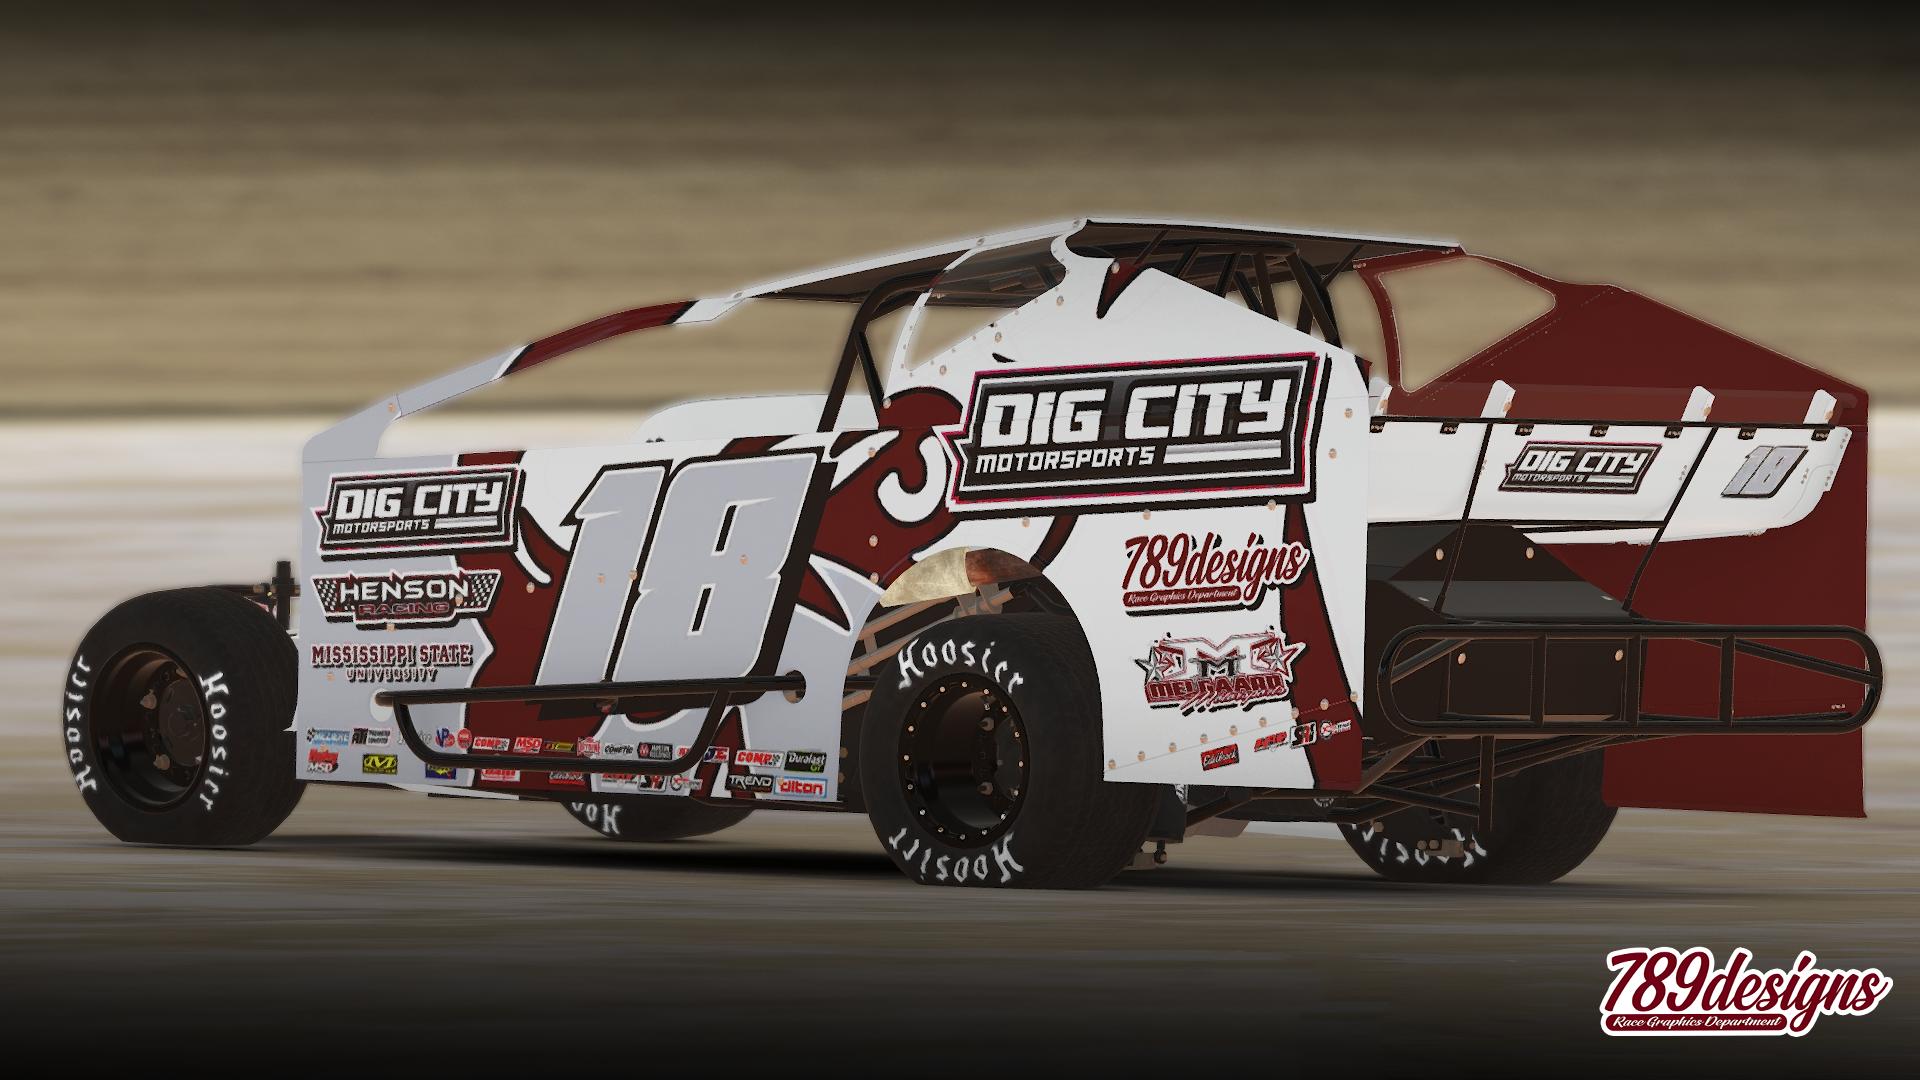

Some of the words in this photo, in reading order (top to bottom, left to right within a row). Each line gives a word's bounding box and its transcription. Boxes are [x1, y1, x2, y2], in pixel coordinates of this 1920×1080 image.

[980, 389, 1107, 448] DIG
[1124, 378, 1294, 439] CITY
[975, 446, 1157, 474] MOTORSPORTS
[1517, 450, 1576, 473] DIG
[1575, 451, 1648, 474] CITY
[1720, 446, 1808, 498] 18
[1512, 473, 1585, 483] MOTORSPORTS
[335, 486, 404, 521] DIG
[412, 481, 504, 517] CITY
[332, 518, 431, 535] MOTORSPORTS
[534, 452, 820, 687] 18
[1121, 531, 1309, 602] 789designs
[339, 578, 469, 603] HENSON
[358, 602, 450, 615] RACING
[311, 644, 415, 665] MISSISSIPPI
[418, 643, 474, 664] STATE
[897, 638, 1024, 694] Hoosier
[346, 667, 437, 682] UNIVERSITY
[728, 775, 773, 790] TREND
